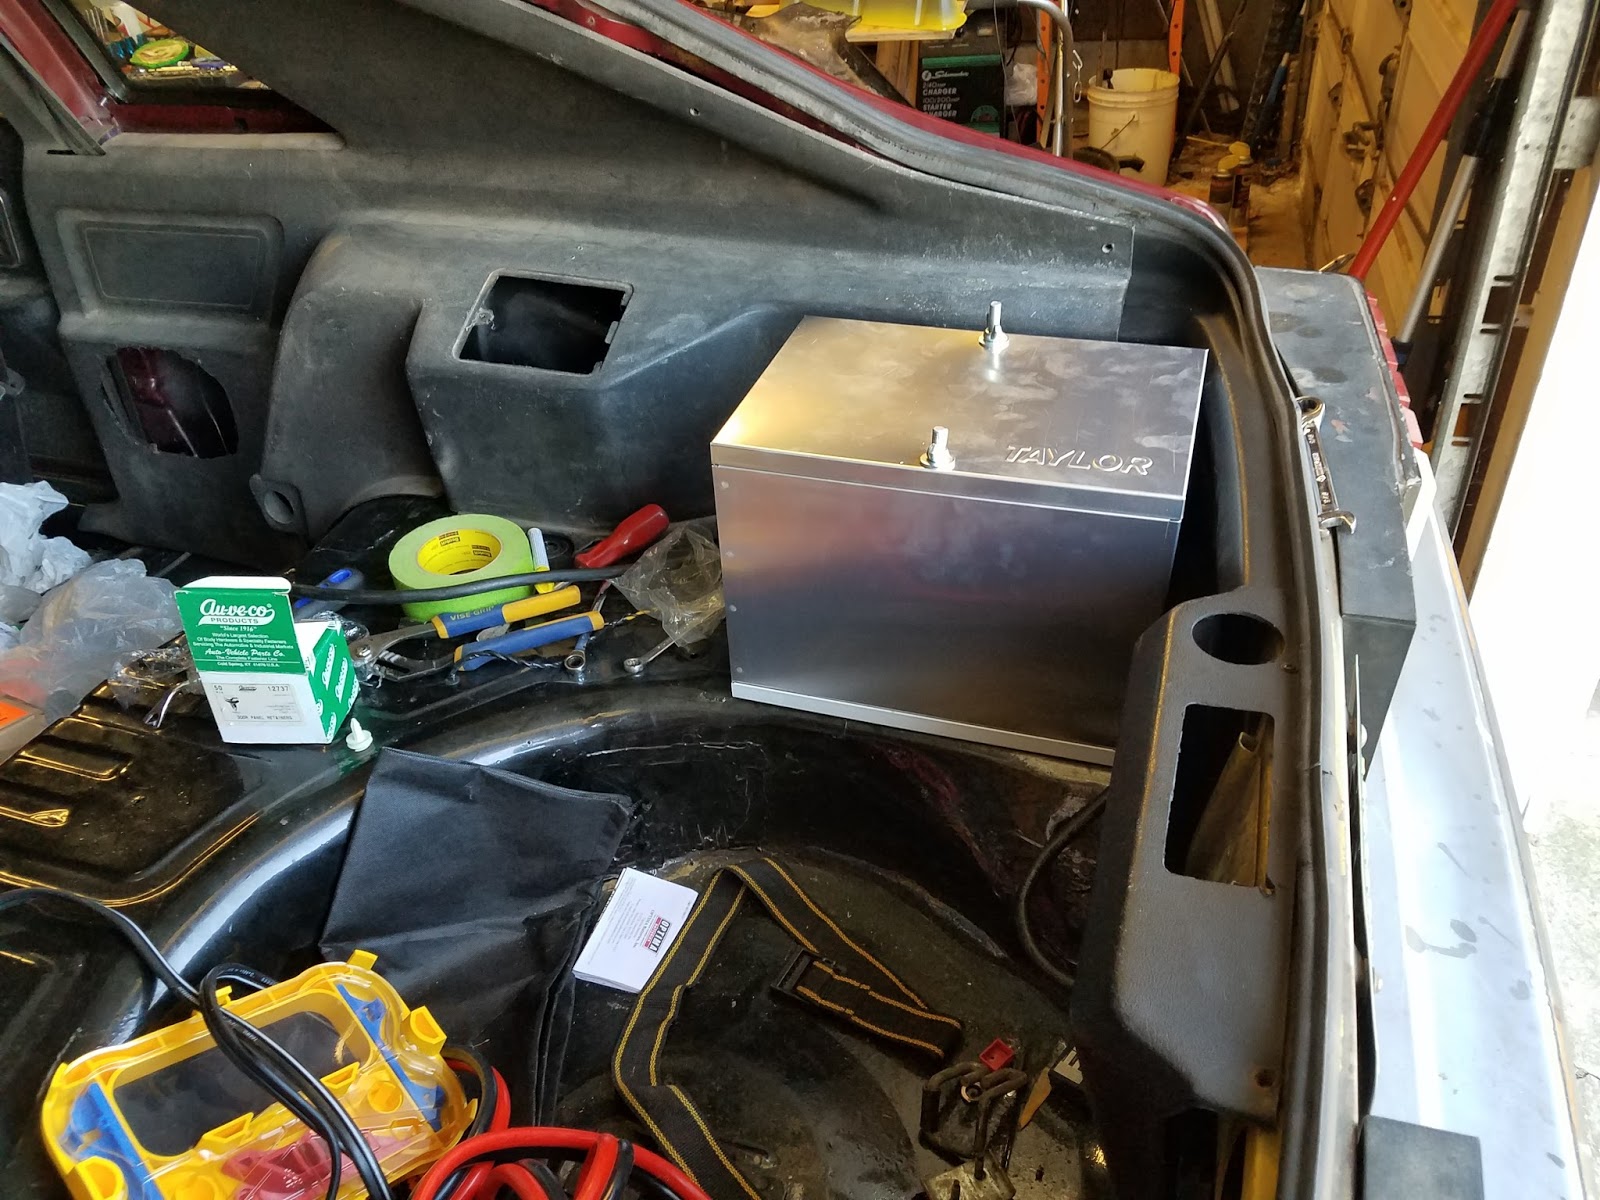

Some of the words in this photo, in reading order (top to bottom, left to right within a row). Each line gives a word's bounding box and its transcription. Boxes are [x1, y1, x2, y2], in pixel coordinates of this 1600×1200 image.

[923, 88, 957, 96] CHARGER
[923, 103, 952, 111] STARTER
[1005, 445, 1153, 476] TAYLOR
[205, 648, 249, 656] Auto-Vehicle
[250, 648, 271, 657] Parts
[272, 649, 285, 657] Co.
[648, 918, 670, 953] OPTIMA
